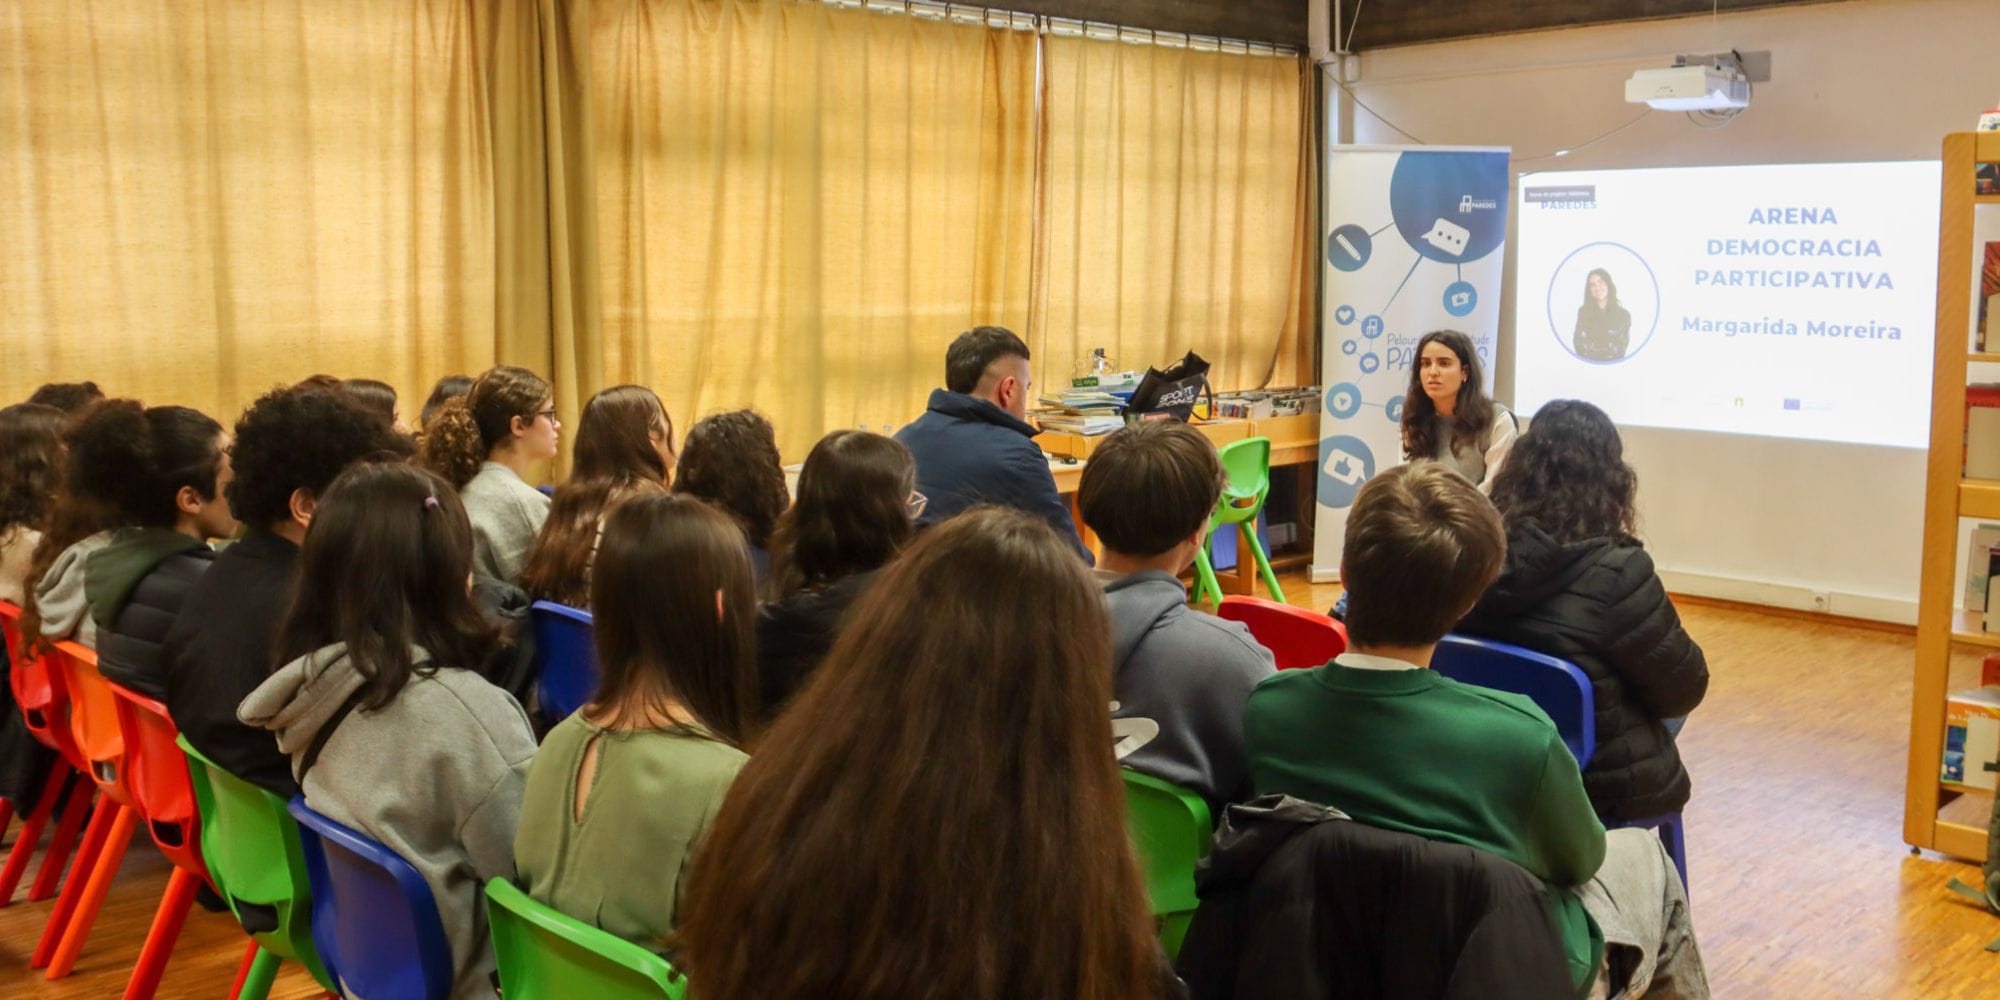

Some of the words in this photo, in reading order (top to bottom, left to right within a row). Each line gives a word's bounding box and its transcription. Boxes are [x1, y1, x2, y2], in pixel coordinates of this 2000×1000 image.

[1748, 207, 1838, 225] ARENA
[1707, 239, 1882, 257] DEMOCRACIA
[1695, 269, 1894, 290] PARTICIPATIVA
[1682, 316, 1798, 337] Margarida
[1806, 320, 1902, 340] Moreira
